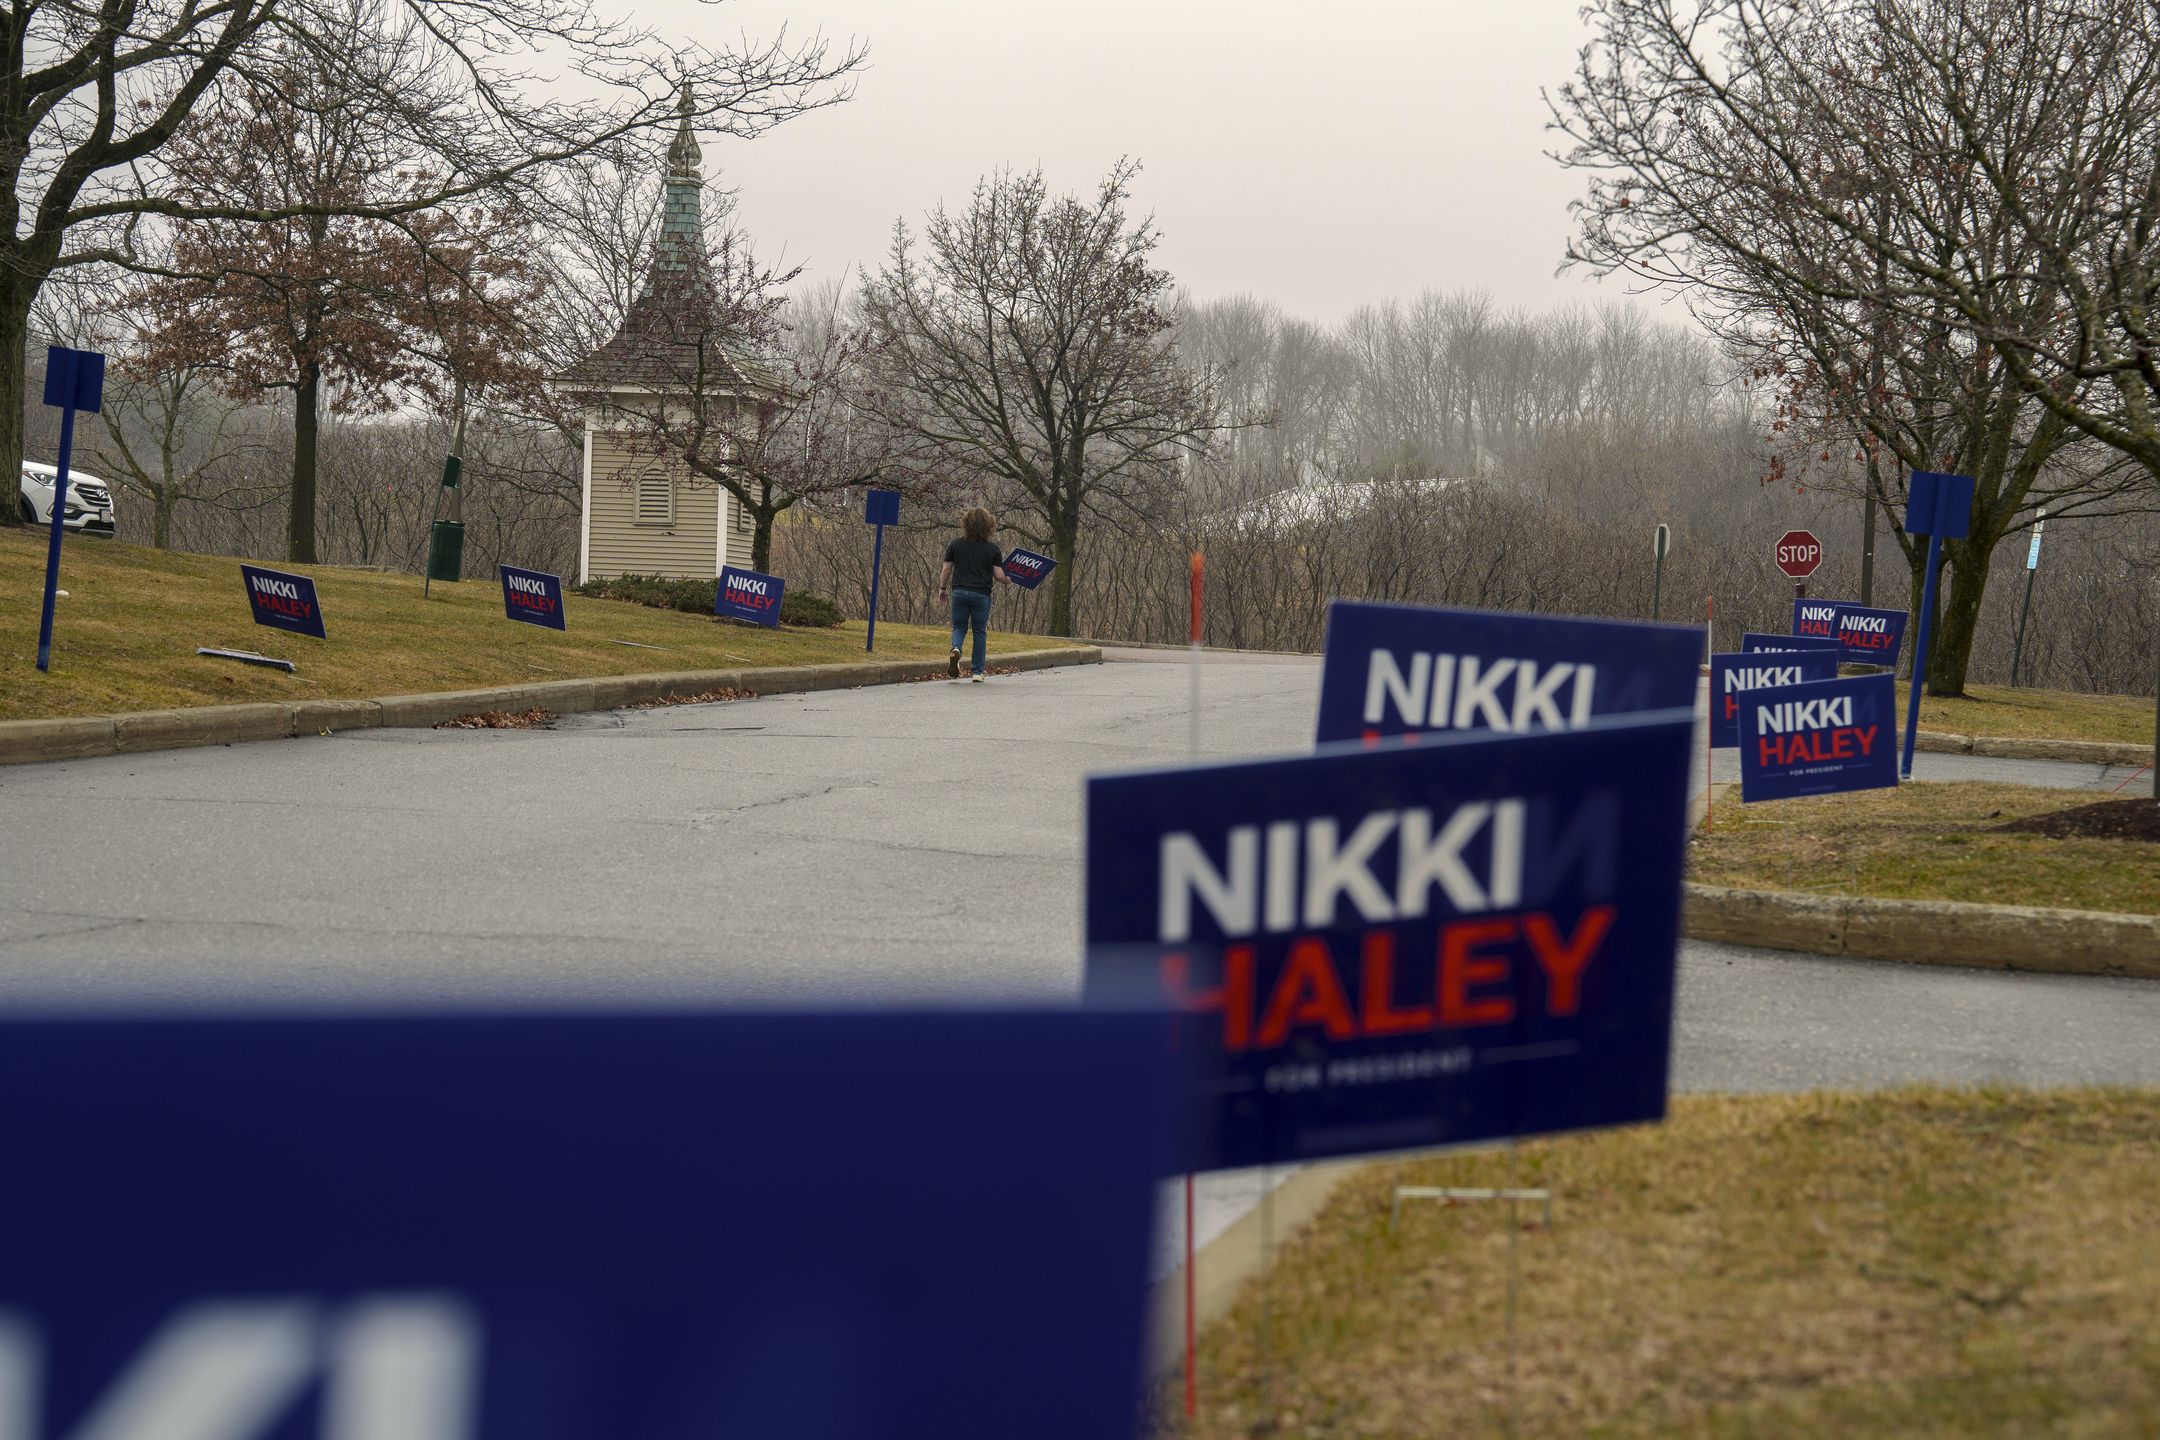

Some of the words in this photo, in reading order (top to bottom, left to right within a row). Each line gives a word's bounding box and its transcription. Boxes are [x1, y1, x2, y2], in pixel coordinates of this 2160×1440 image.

[1012, 553, 1043, 570] NIKKI
[1779, 545, 1818, 563] STOP
[252, 575, 298, 600] NIKKI
[508, 574, 546, 596] NIKKI
[727, 574, 767, 595] NIKKI
[256, 591, 312, 620] HALEY
[511, 591, 556, 613] HALEY
[724, 587, 775, 610] HALEY
[1801, 606, 1836, 621] NIKK
[1840, 615, 1887, 633] NIKKI
[1800, 620, 1831, 635] HAL
[1838, 630, 1895, 649] HALEY
[1363, 649, 1597, 733] NIKKI
[1724, 666, 1802, 694] NIKKI
[1757, 696, 1853, 735] NIKKI
[1759, 725, 1878, 767] HALEY
[1805, 765, 1844, 775] PRESIDENT
[1159, 798, 1527, 943] NIKKI
[1158, 906, 1618, 1052] HALEY
